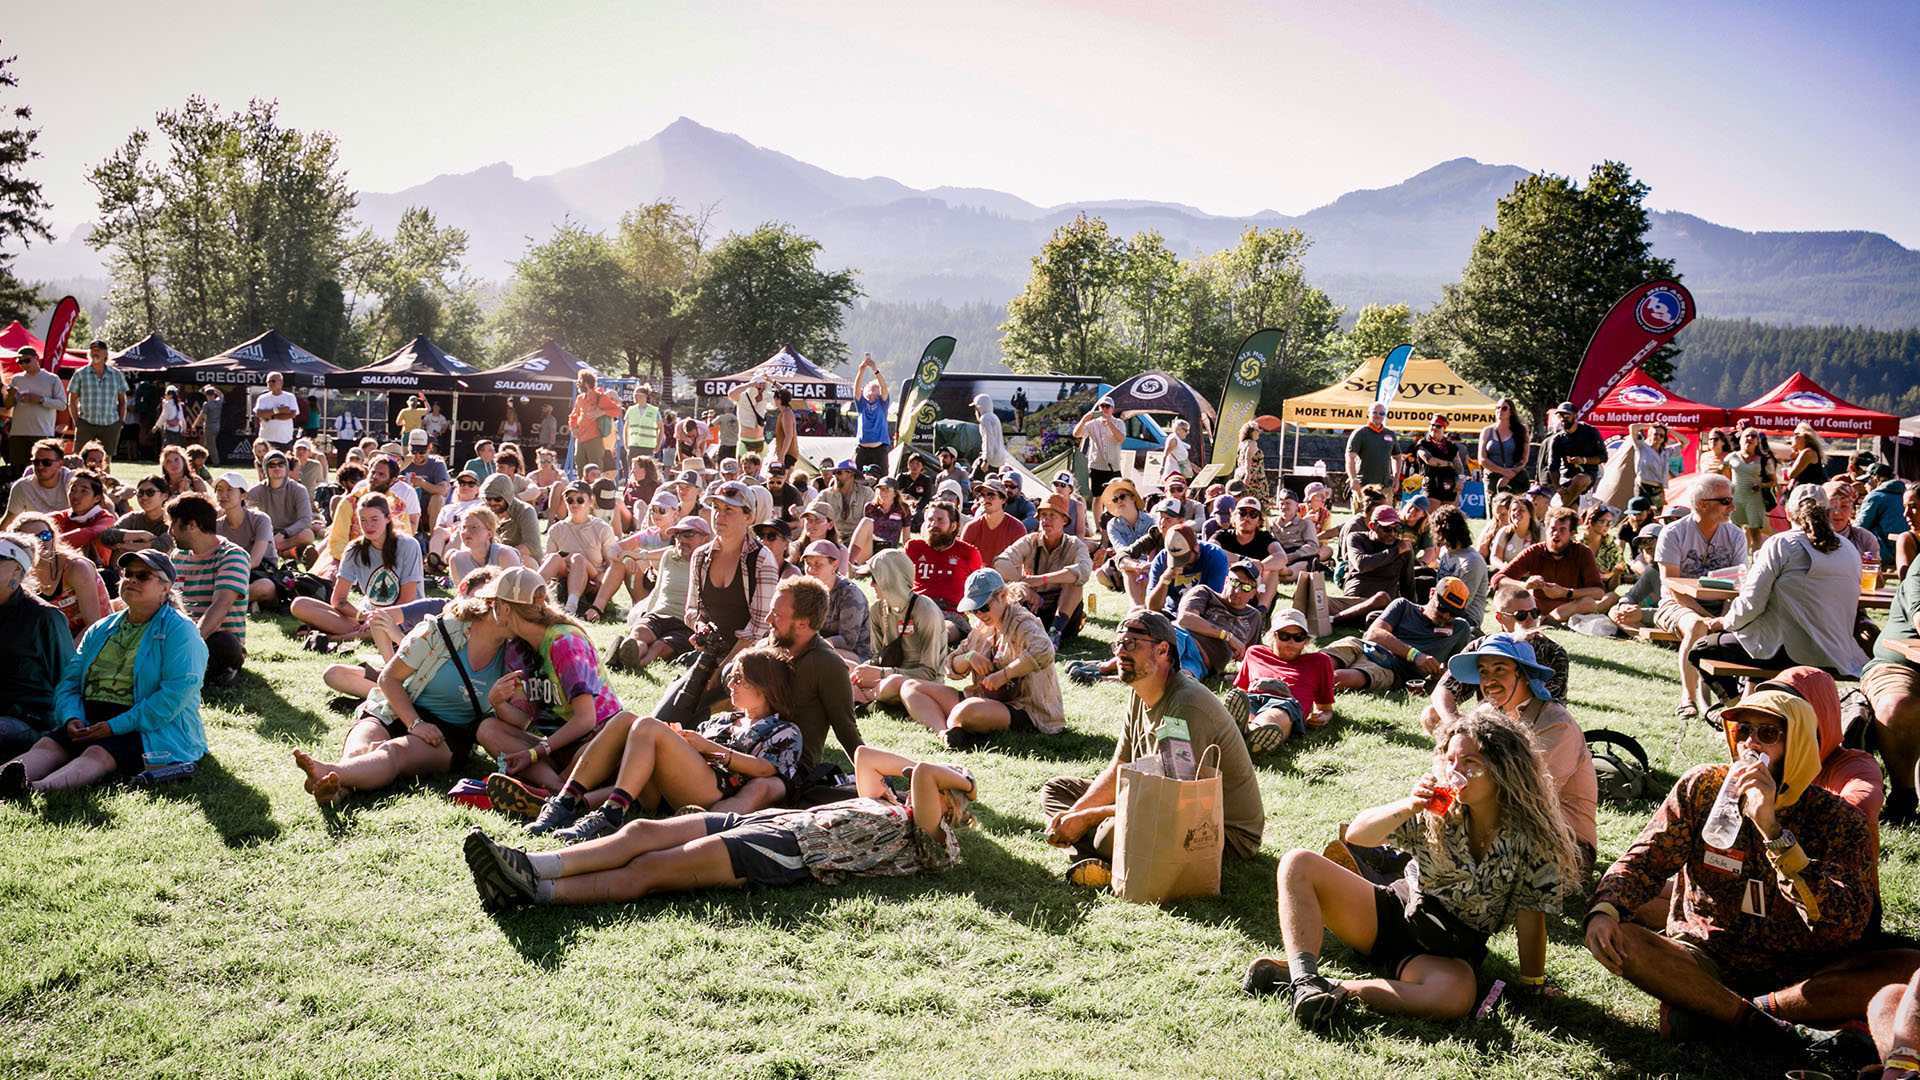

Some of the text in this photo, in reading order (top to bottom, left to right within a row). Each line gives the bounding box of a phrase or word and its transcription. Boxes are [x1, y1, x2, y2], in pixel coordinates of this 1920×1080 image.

[1239, 351, 1251, 361] SIX
[196, 371, 267, 383] GREGORY
[361, 376, 418, 385] SALOMON
[1233, 371, 1262, 387] DESIGNS
[1576, 398, 1595, 420] IG
[1598, 339, 1658, 399] AGNES
[494, 380, 553, 391] SALOMON
[1295, 407, 1327, 416] MORE
[1331, 408, 1363, 418] THAN
[1387, 411, 1433, 420] OUTDOO
[1447, 413, 1496, 422] COMPAN
[1588, 412, 1700, 422] The Mother of Comfort!
[1754, 415, 1772, 425] The
[1814, 417, 1825, 427] of
[1827, 418, 1872, 429] Comfort!
